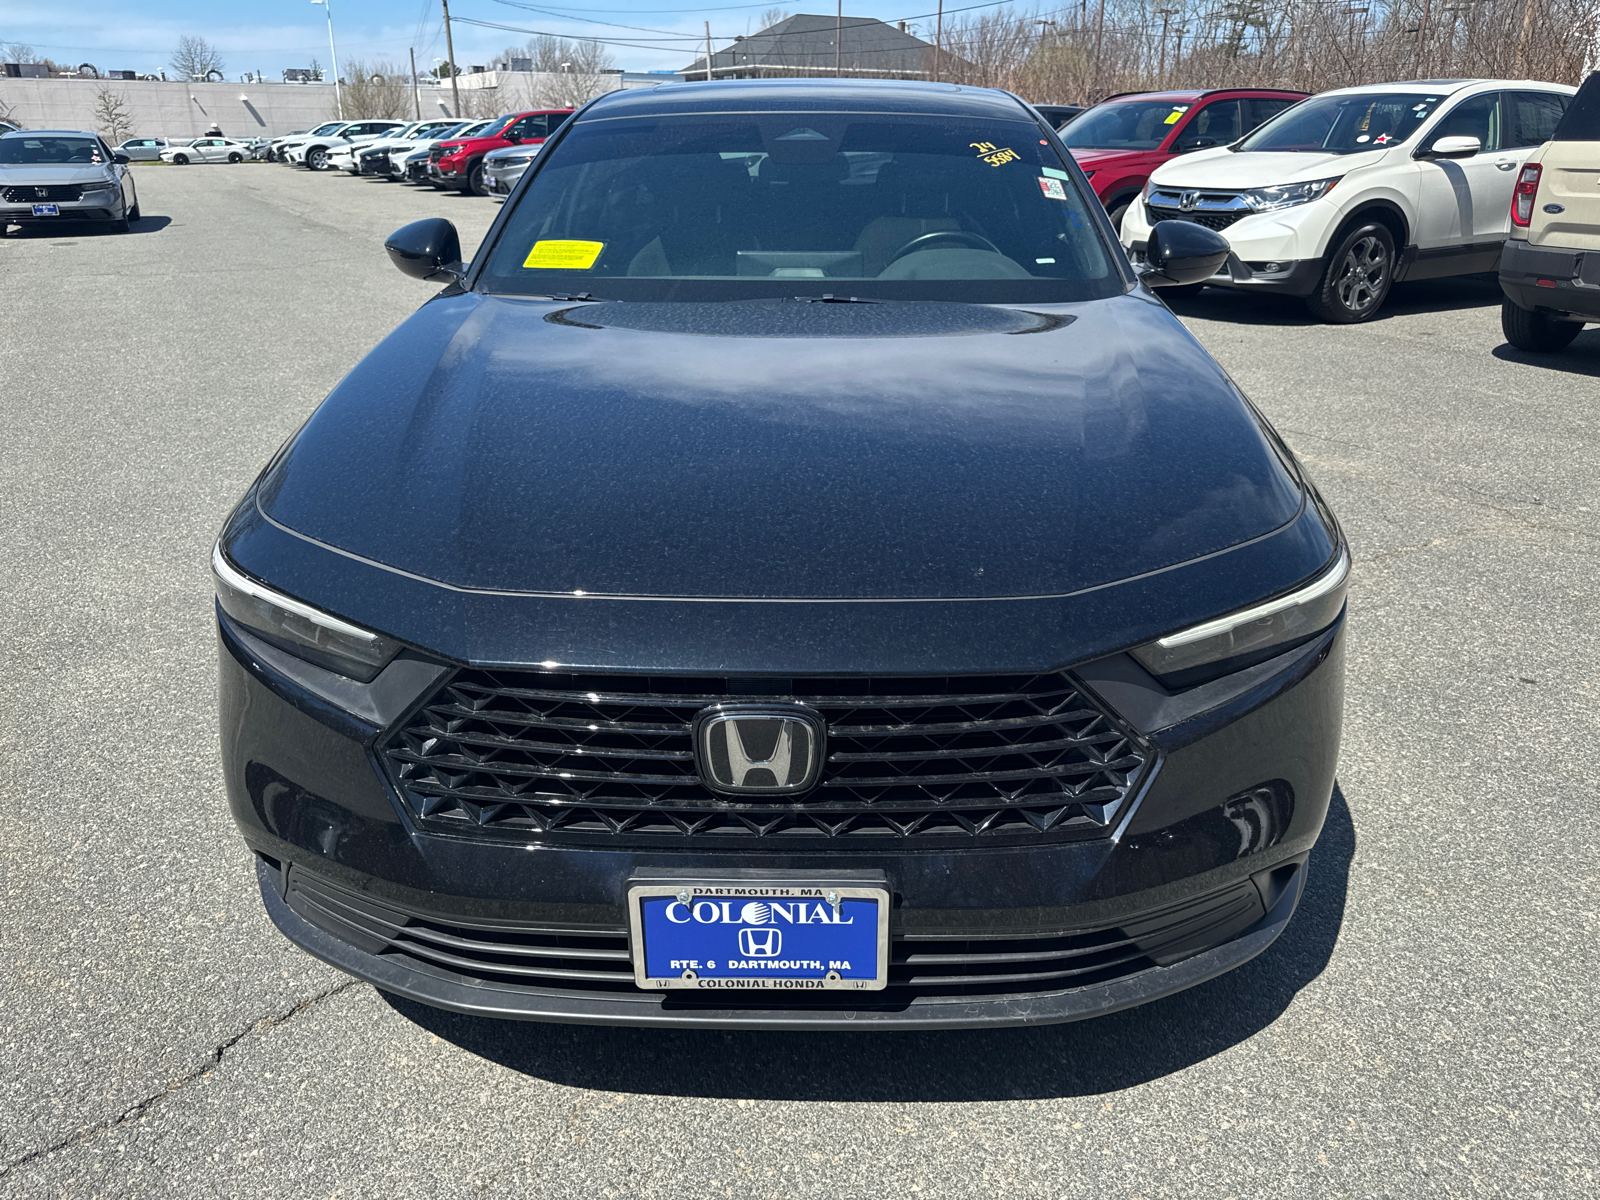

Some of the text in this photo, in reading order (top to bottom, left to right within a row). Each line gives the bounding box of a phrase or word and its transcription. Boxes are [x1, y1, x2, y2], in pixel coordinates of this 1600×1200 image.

[969, 141, 997, 153] 24
[983, 149, 1021, 167] 5584
[800, 888, 823, 896] MA
[665, 901, 854, 925] COLONIAL
[670, 960, 852, 971] RTE. 6 DARTMOUTH, MA
[698, 979, 825, 989] COLONIAL HONDA
